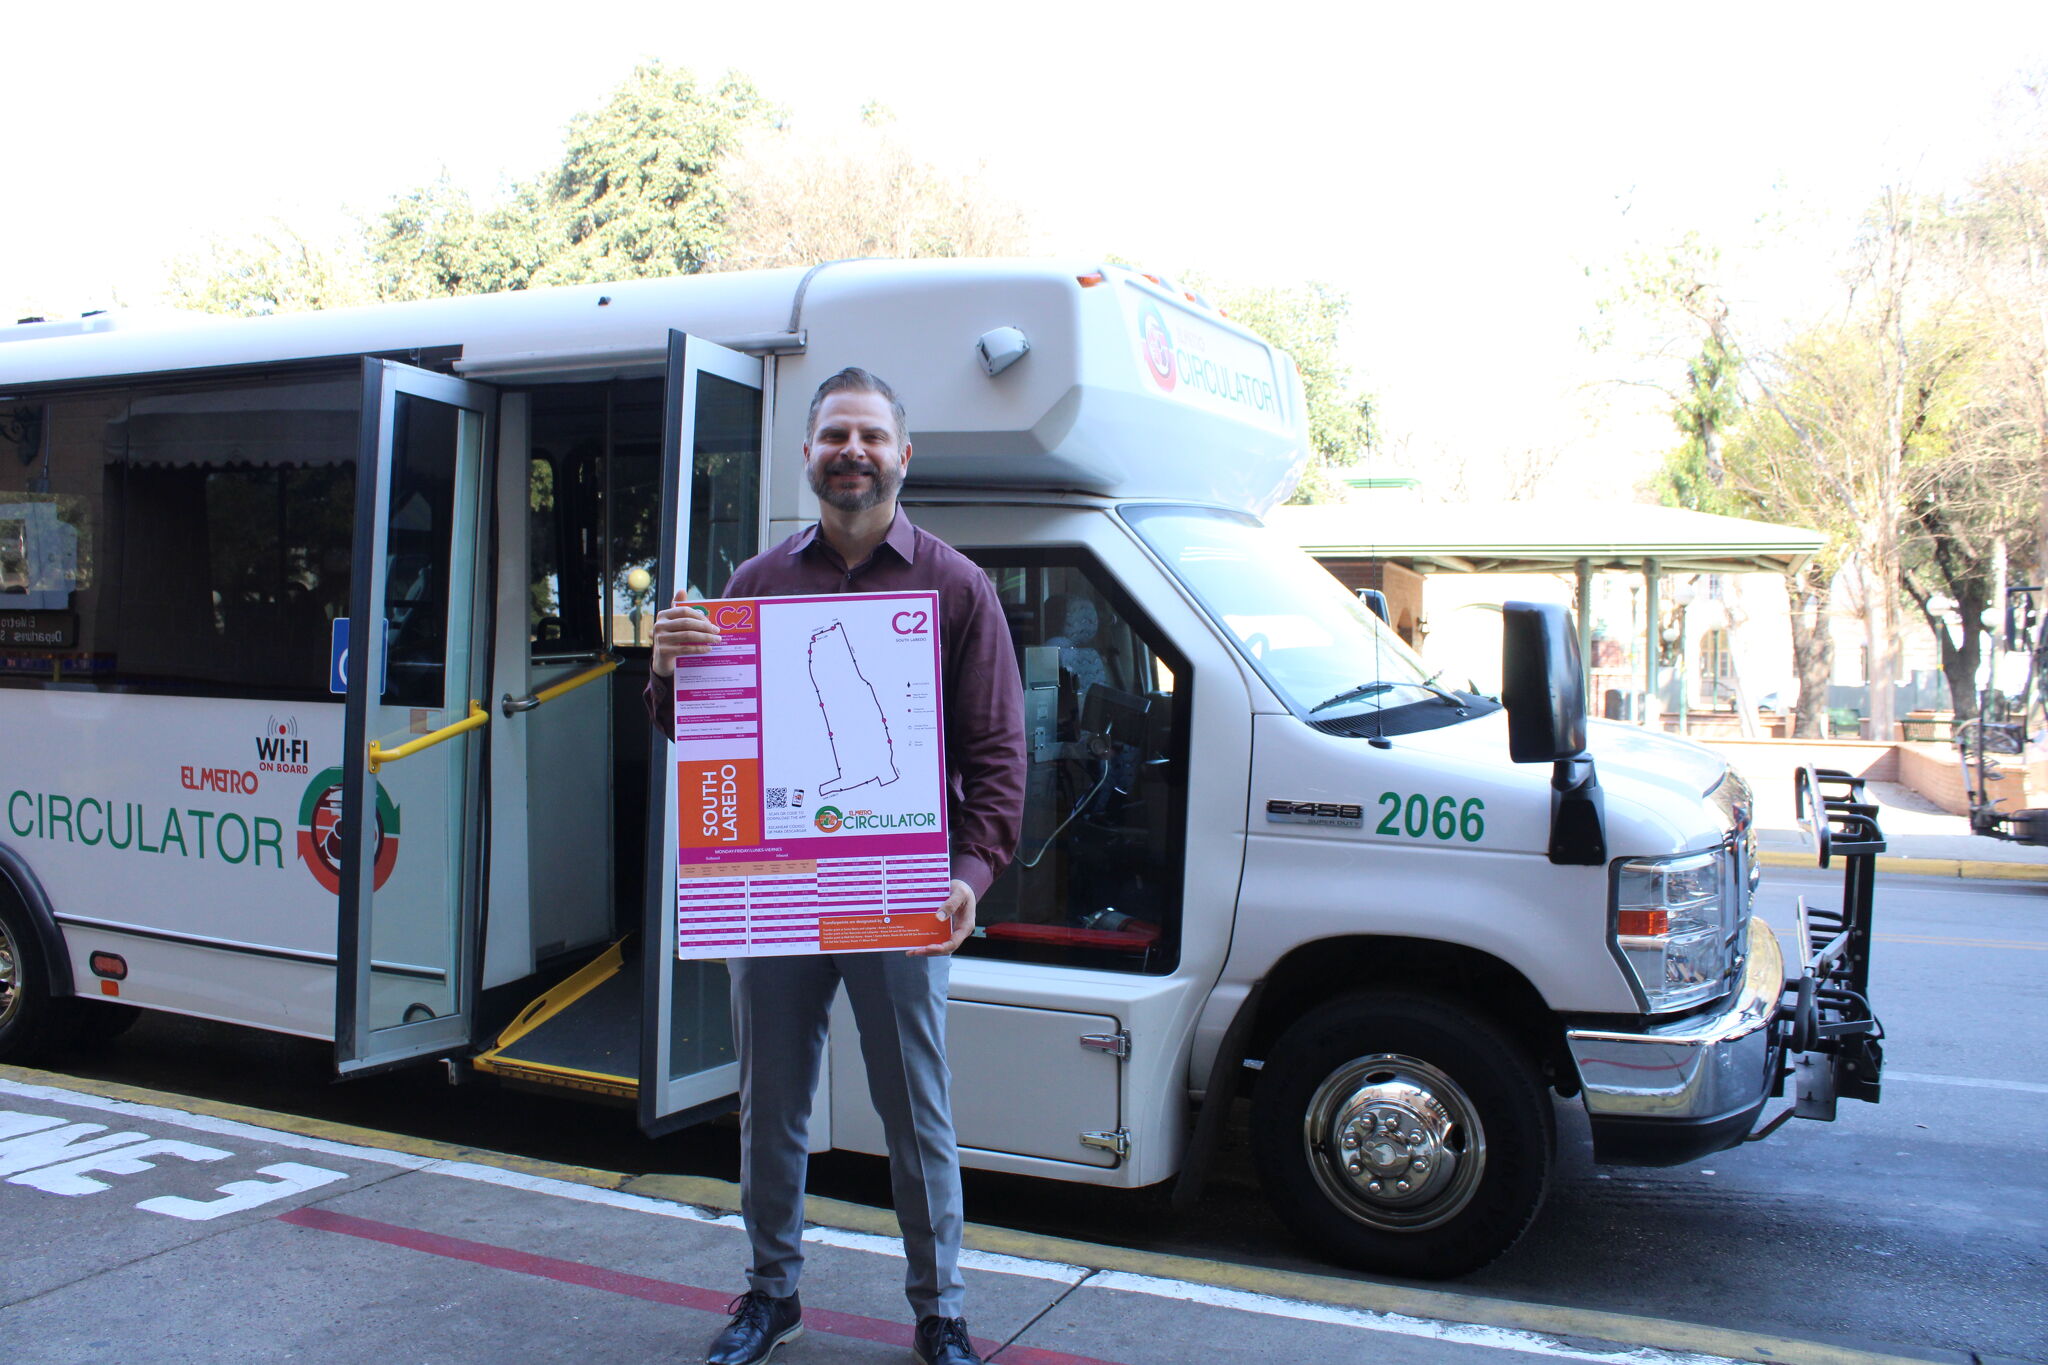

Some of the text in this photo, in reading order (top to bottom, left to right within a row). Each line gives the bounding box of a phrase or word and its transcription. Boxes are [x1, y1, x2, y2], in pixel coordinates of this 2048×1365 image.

[1176, 349, 1276, 414] CIRCULATOR
[715, 605, 753, 630] C2
[892, 611, 928, 635] C2
[259, 762, 308, 775] ON BOARD
[702, 771, 718, 837] SOUTH
[721, 764, 737, 842] LAREDO
[843, 812, 936, 830] CIRCULATOR
[1375, 791, 1485, 842] 2066
[8, 789, 284, 869] CIRCULATOR
